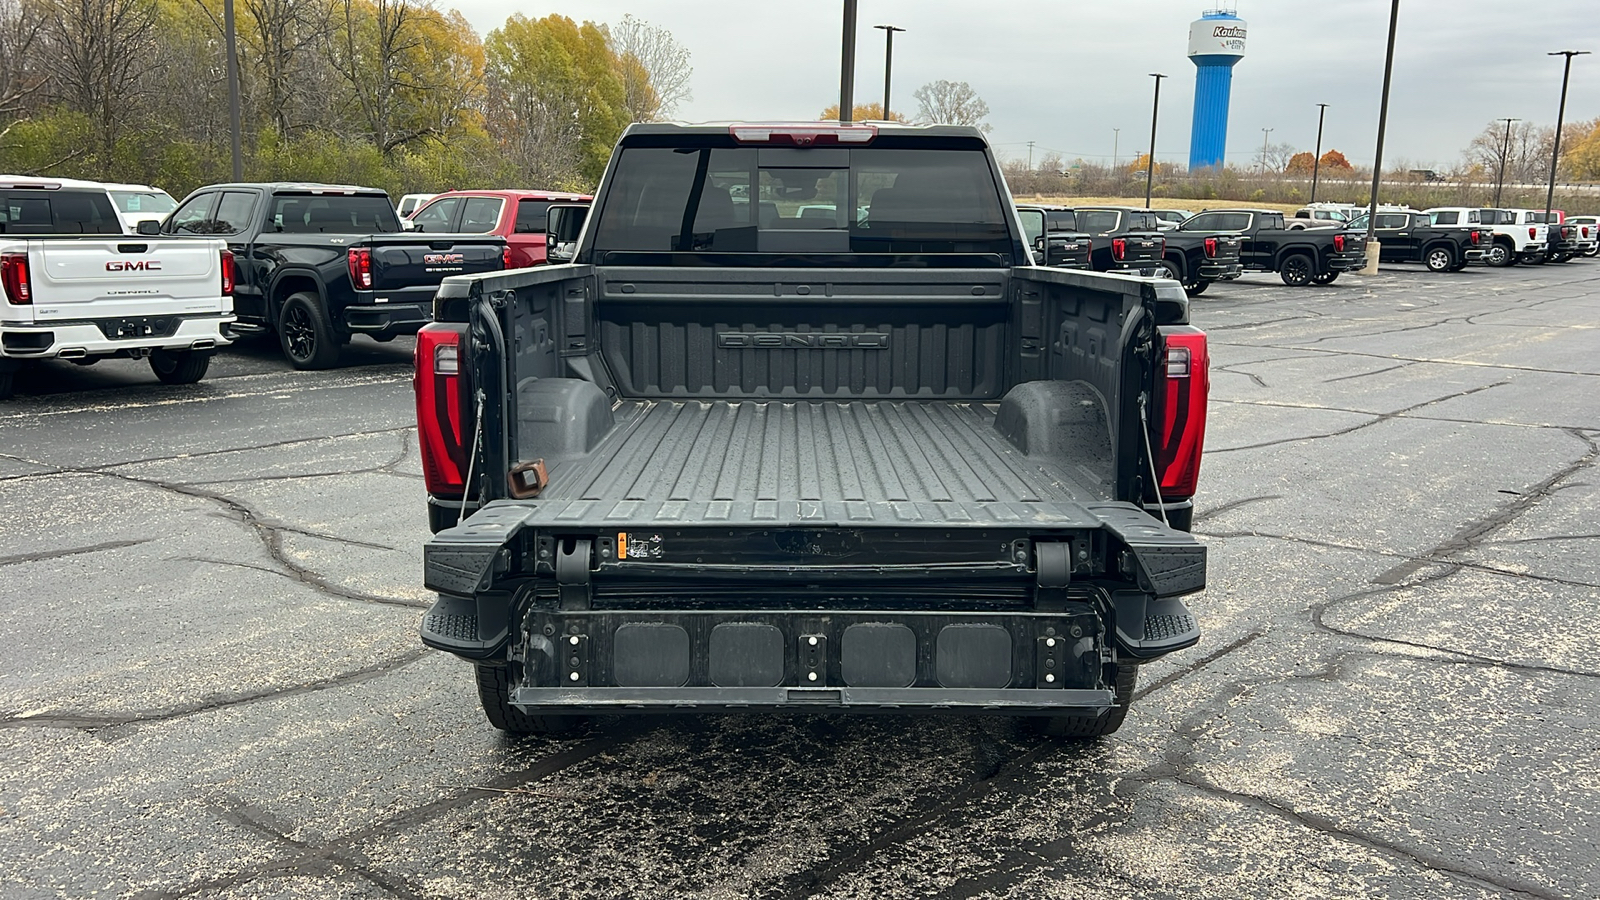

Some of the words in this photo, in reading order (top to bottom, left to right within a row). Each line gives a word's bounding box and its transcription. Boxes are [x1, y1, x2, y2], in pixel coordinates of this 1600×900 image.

[424, 254, 464, 264] GMC
[106, 260, 162, 271] GMC
[719, 334, 887, 347] DENALI
